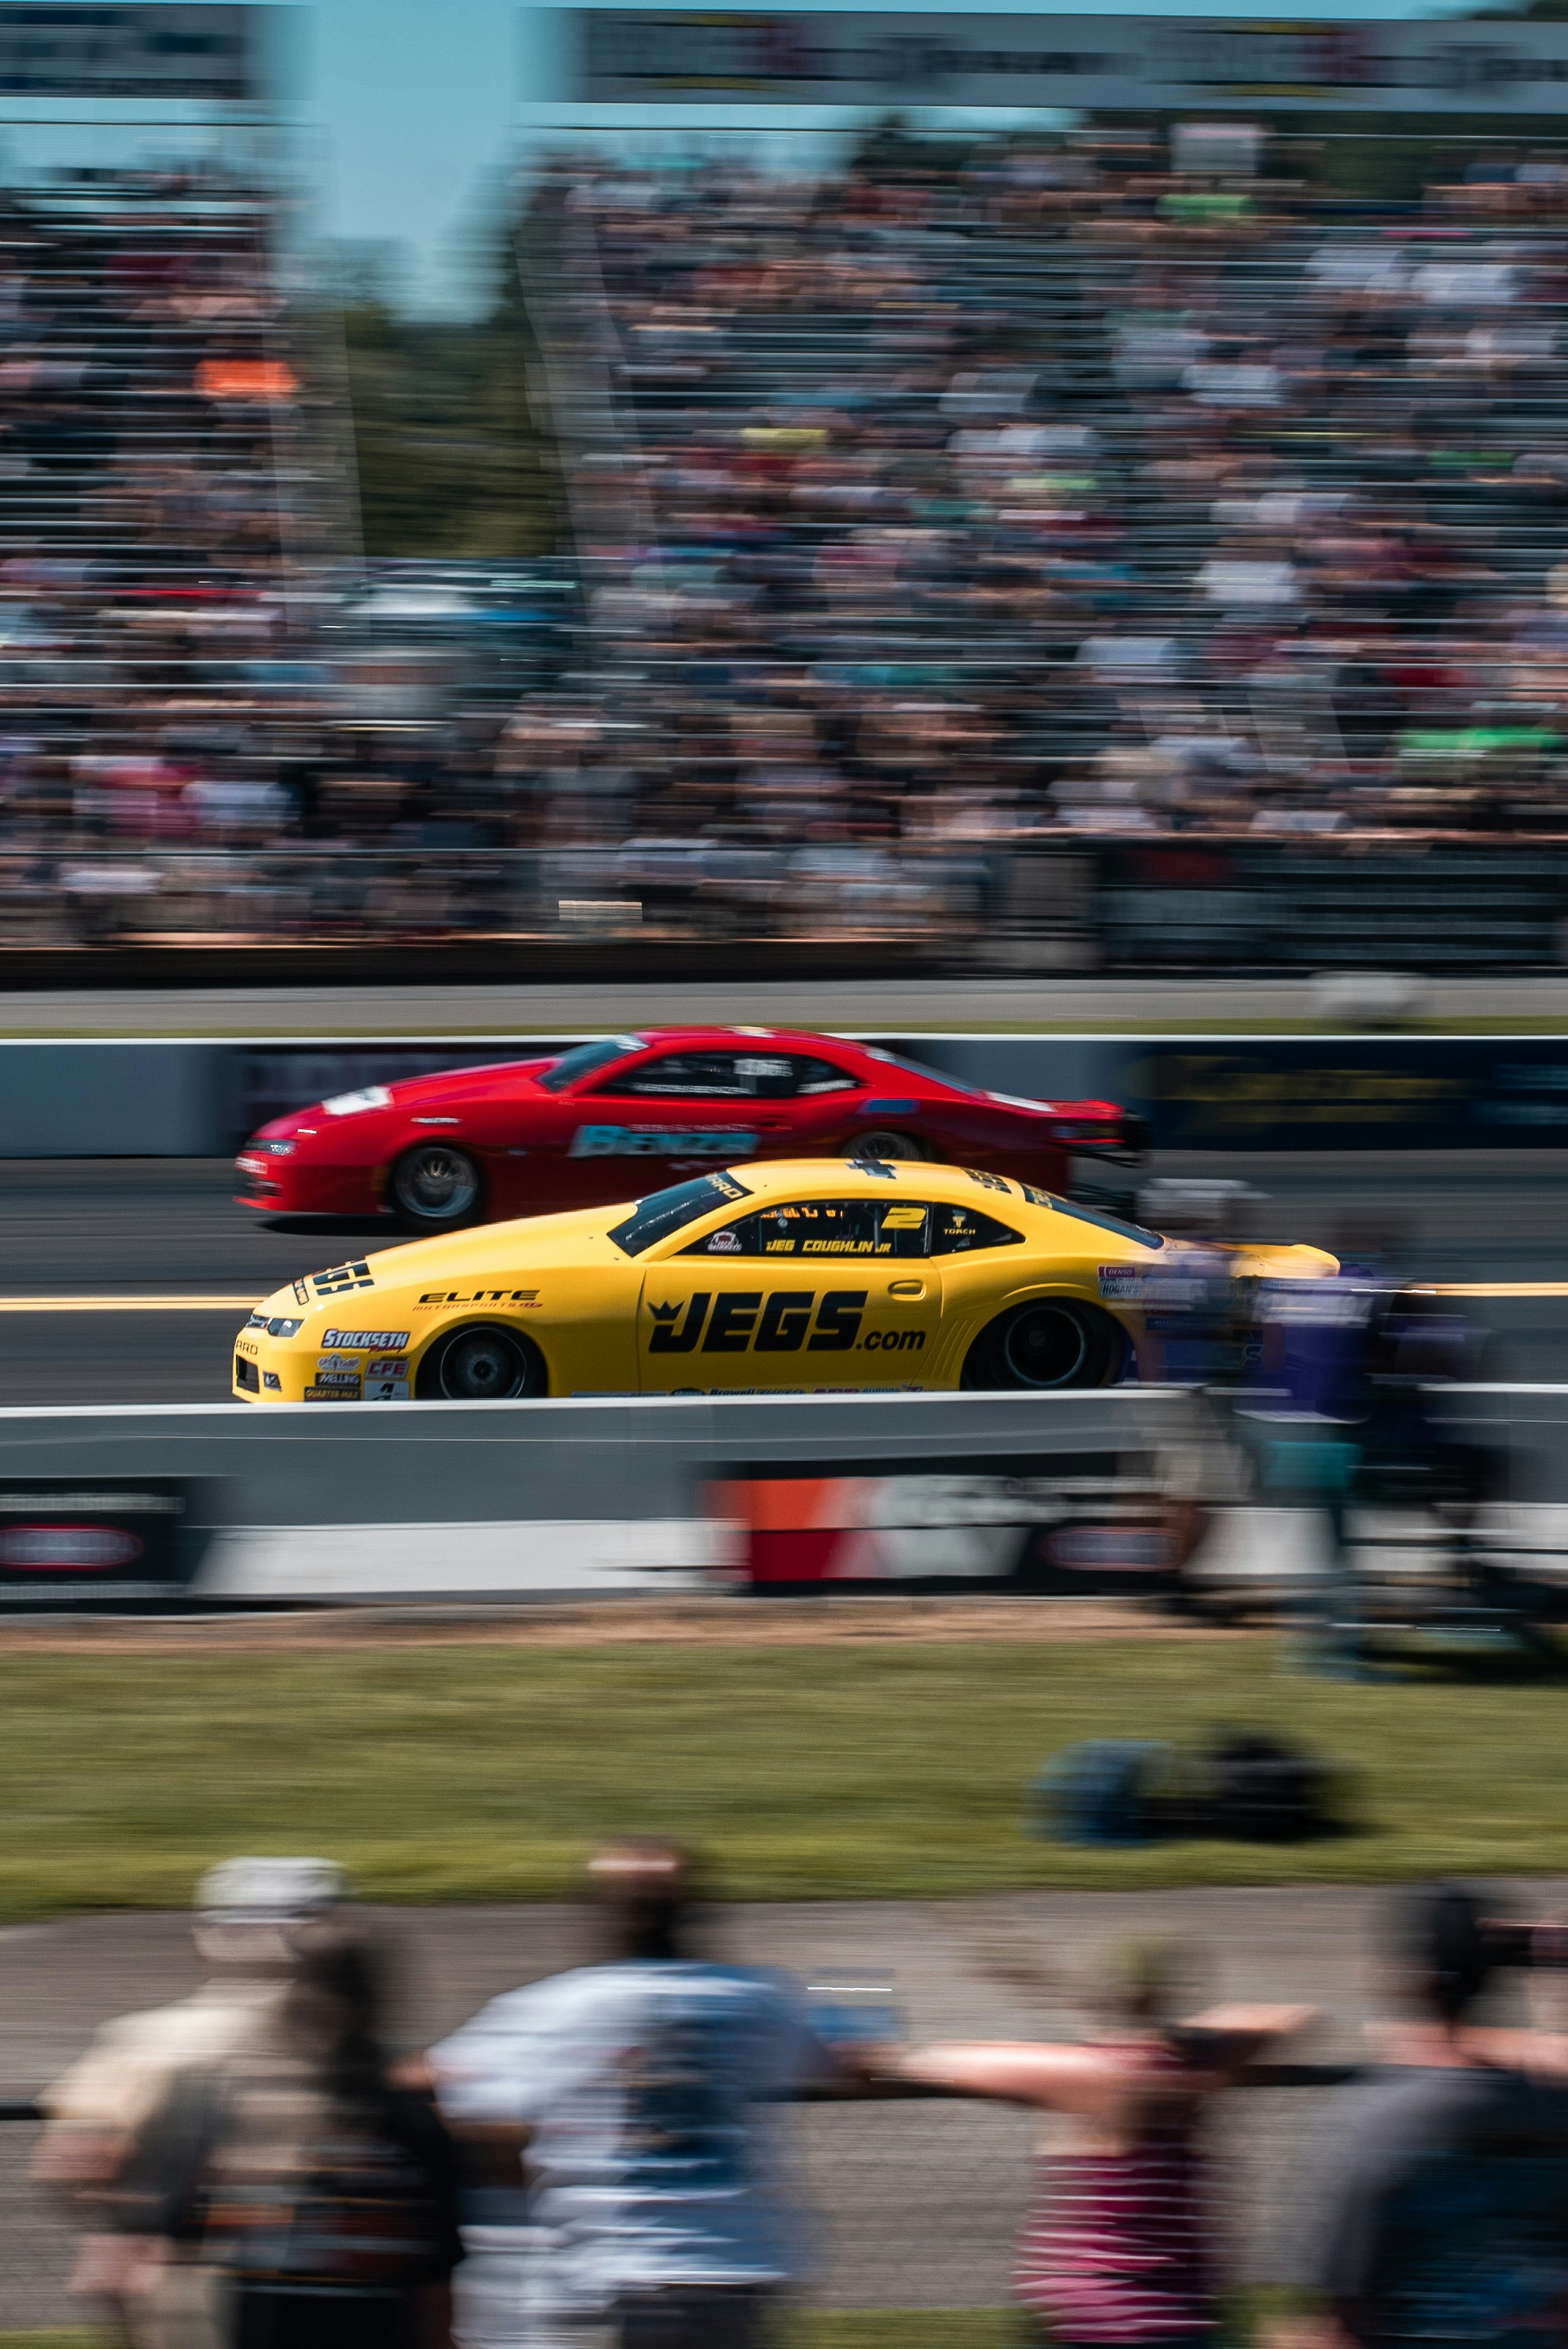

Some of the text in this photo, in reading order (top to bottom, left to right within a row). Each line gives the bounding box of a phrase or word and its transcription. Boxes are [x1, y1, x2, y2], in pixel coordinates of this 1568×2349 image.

[881, 1207, 926, 1229] 2
[766, 1239, 892, 1253] JEG COUGHLIN JR
[1102, 1283, 1139, 1294] HOGAN'S
[418, 1290, 541, 1303] ELITE
[412, 1302, 516, 1312] MOTORSPORTS
[646, 1290, 926, 1353] JEGS.com
[322, 1329, 410, 1348] STOCKSETH
[368, 1361, 407, 1375] CFE
